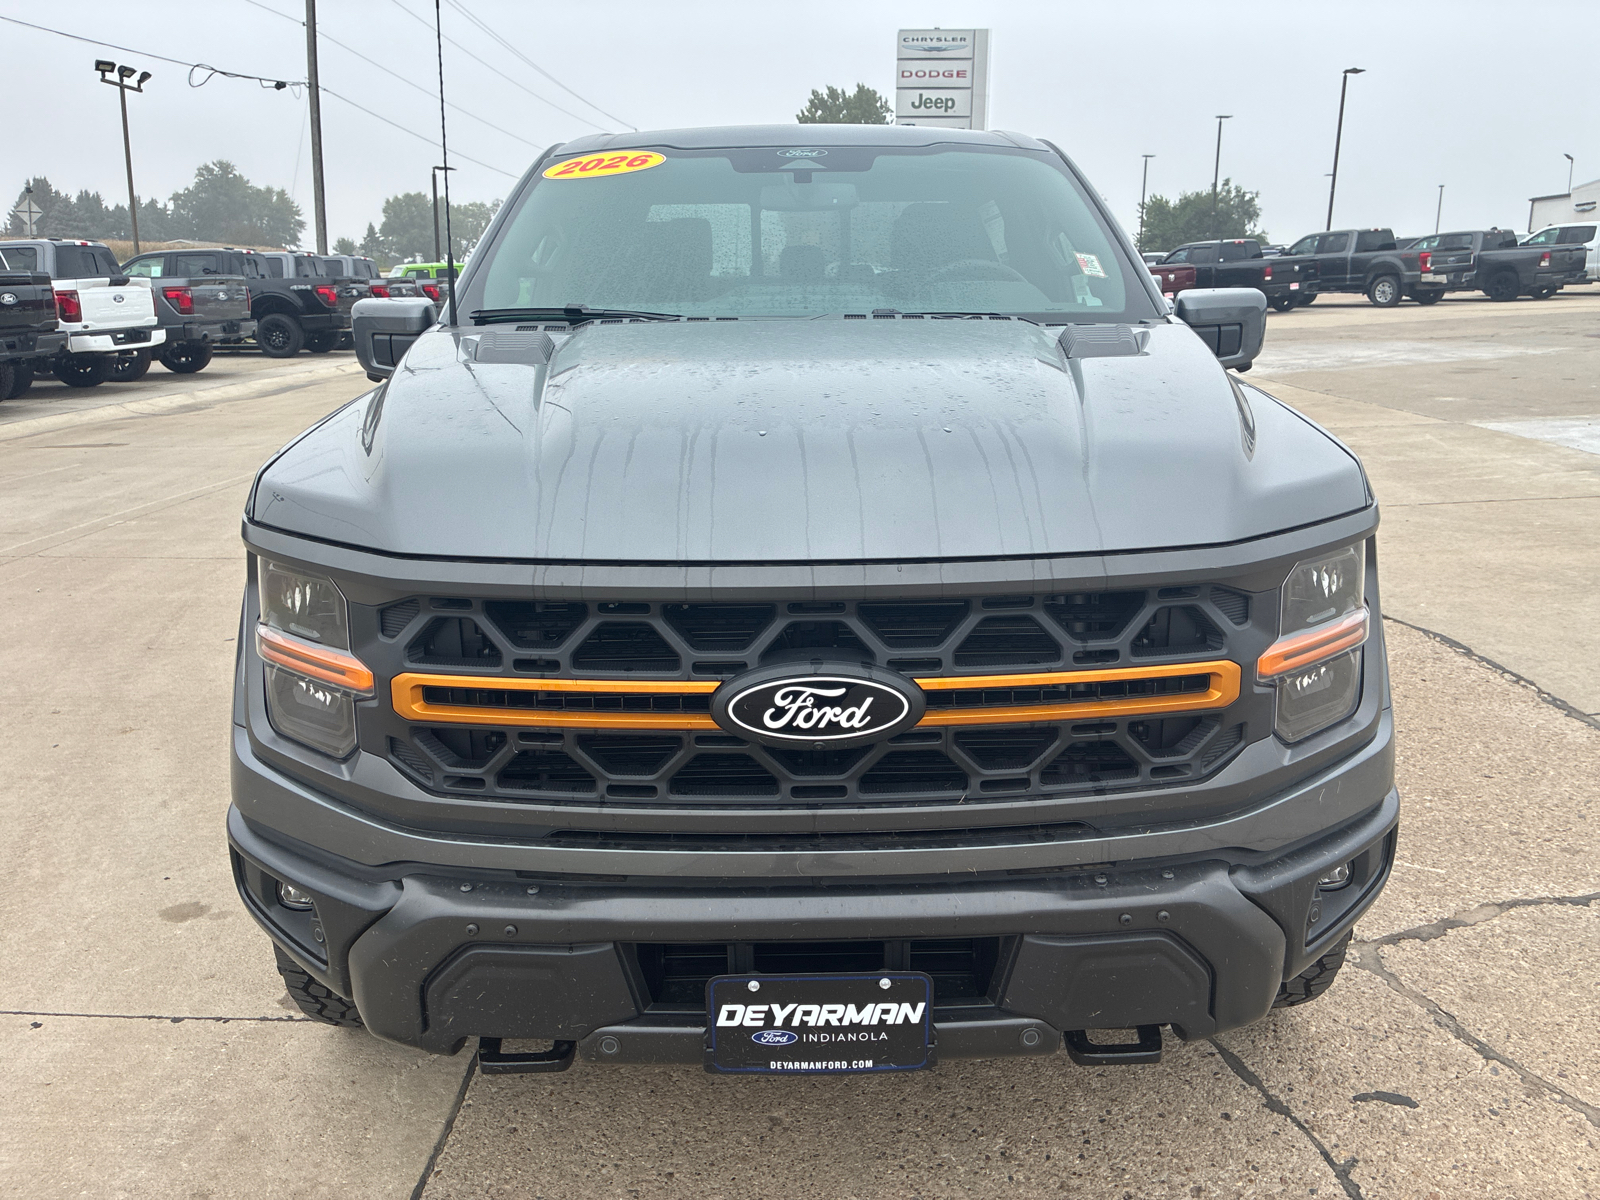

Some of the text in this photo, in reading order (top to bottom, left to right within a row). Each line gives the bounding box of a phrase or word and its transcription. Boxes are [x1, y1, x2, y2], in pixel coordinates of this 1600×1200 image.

[901, 70, 967, 78] DODGE
[911, 93, 956, 113] Jeep
[553, 154, 654, 177] 2026
[763, 686, 874, 729] Ford
[716, 1002, 926, 1027] DEYARMAN
[761, 1031, 888, 1043] Ford INDIANOLA
[770, 1059, 873, 1070] DEYARMANFORD.COM
